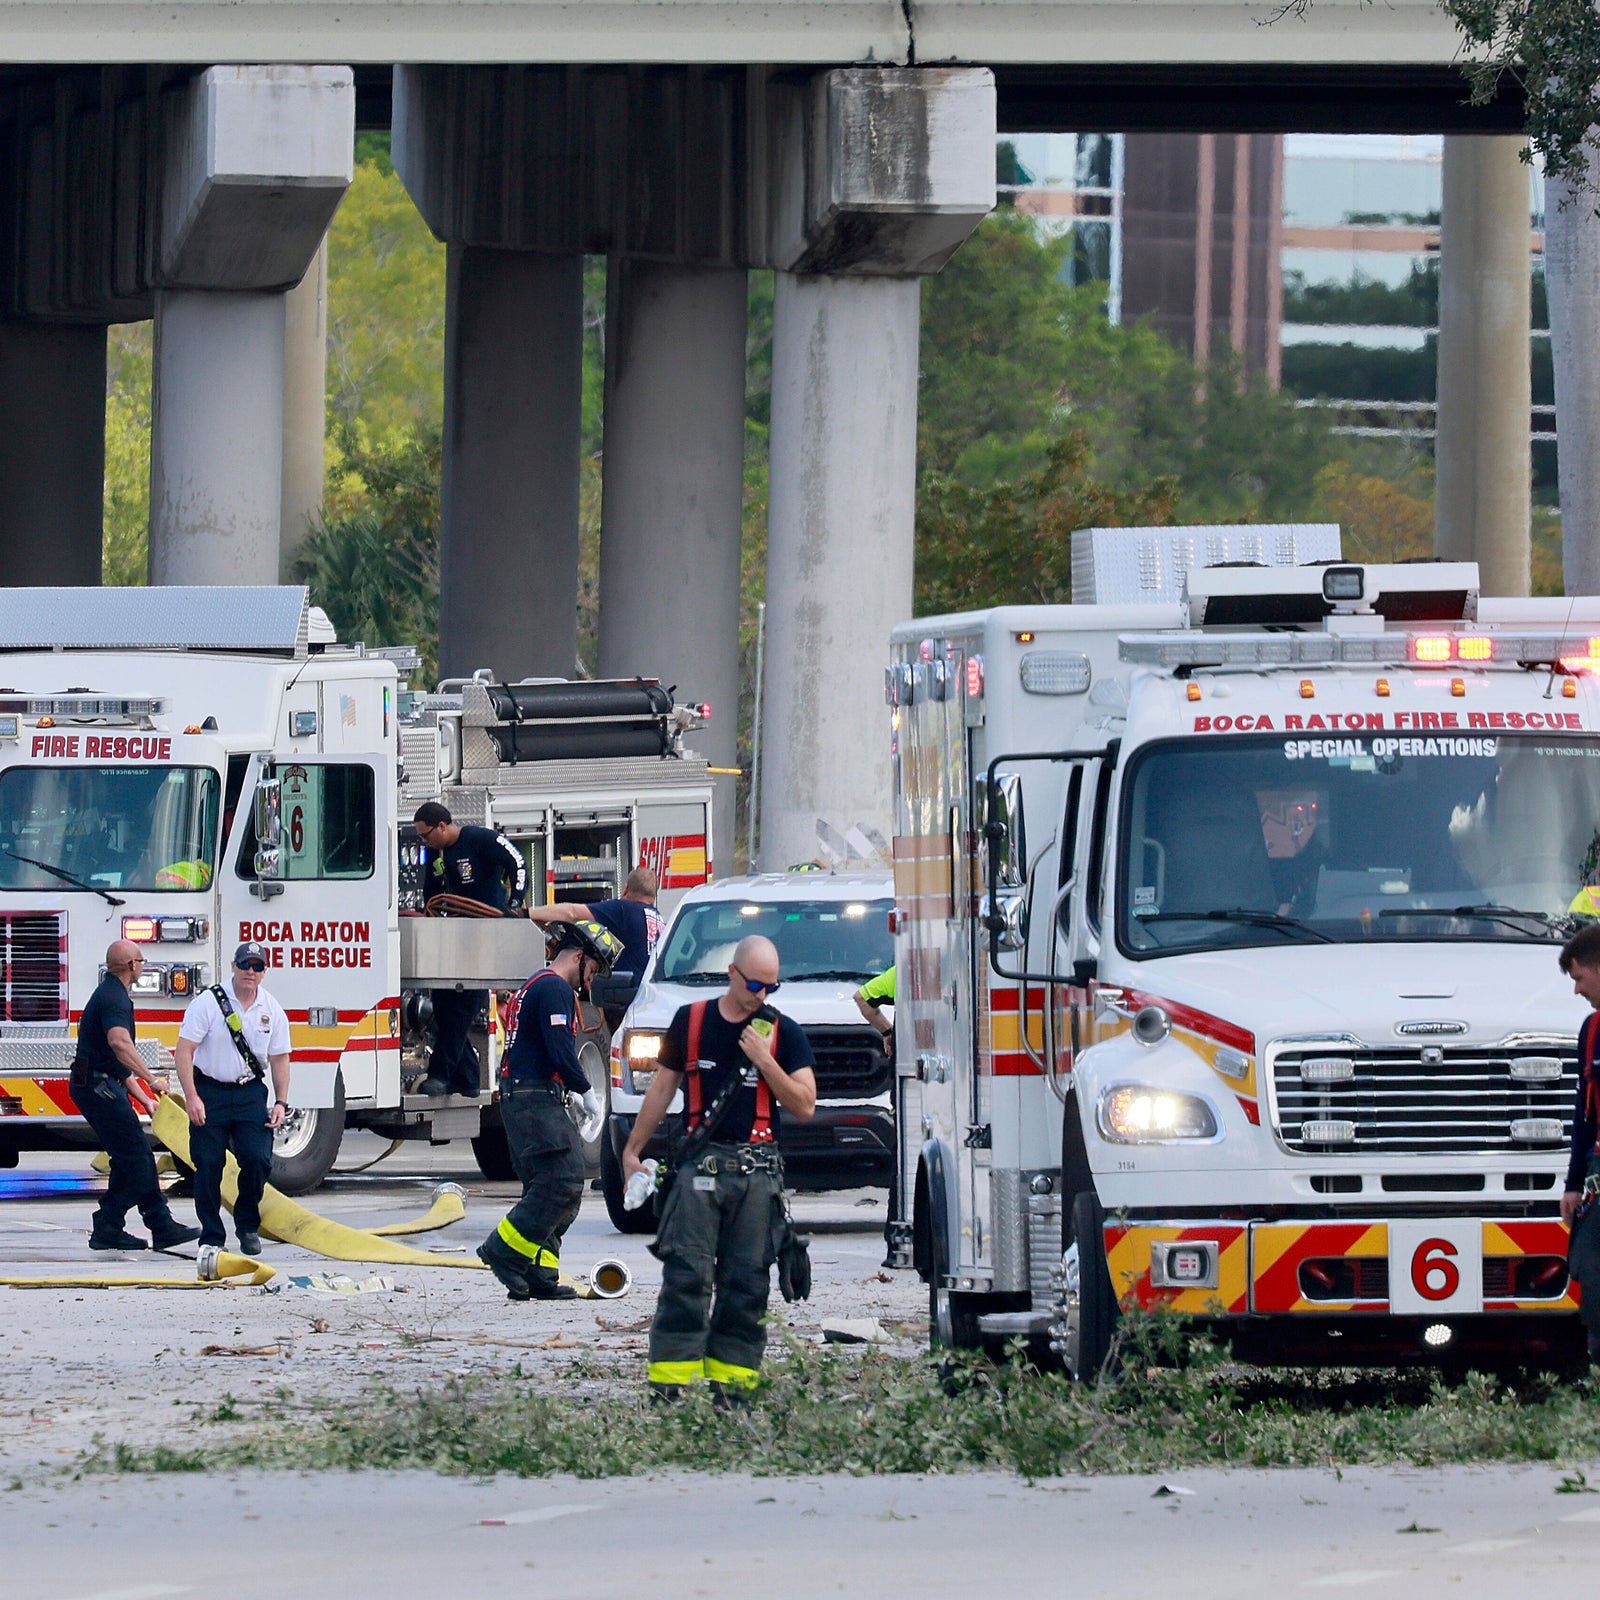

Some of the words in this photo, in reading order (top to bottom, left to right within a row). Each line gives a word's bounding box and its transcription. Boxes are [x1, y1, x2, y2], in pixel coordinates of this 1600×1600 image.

[1194, 714, 1274, 732] BOCA
[1284, 712, 1385, 731] RATON
[1394, 711, 1459, 729] FIRE
[1467, 711, 1583, 730] RESCUE
[31, 735, 79, 758] FIRE
[85, 736, 171, 760] RESCUE
[1284, 740, 1368, 760] SPECIAL
[1372, 737, 1498, 757] OPERATIONS
[291, 805, 304, 853] 6
[239, 921, 294, 942] BOCA
[300, 921, 370, 942] RATON
[290, 947, 372, 968] RESCUE
[1411, 1237, 1460, 1302] 6
